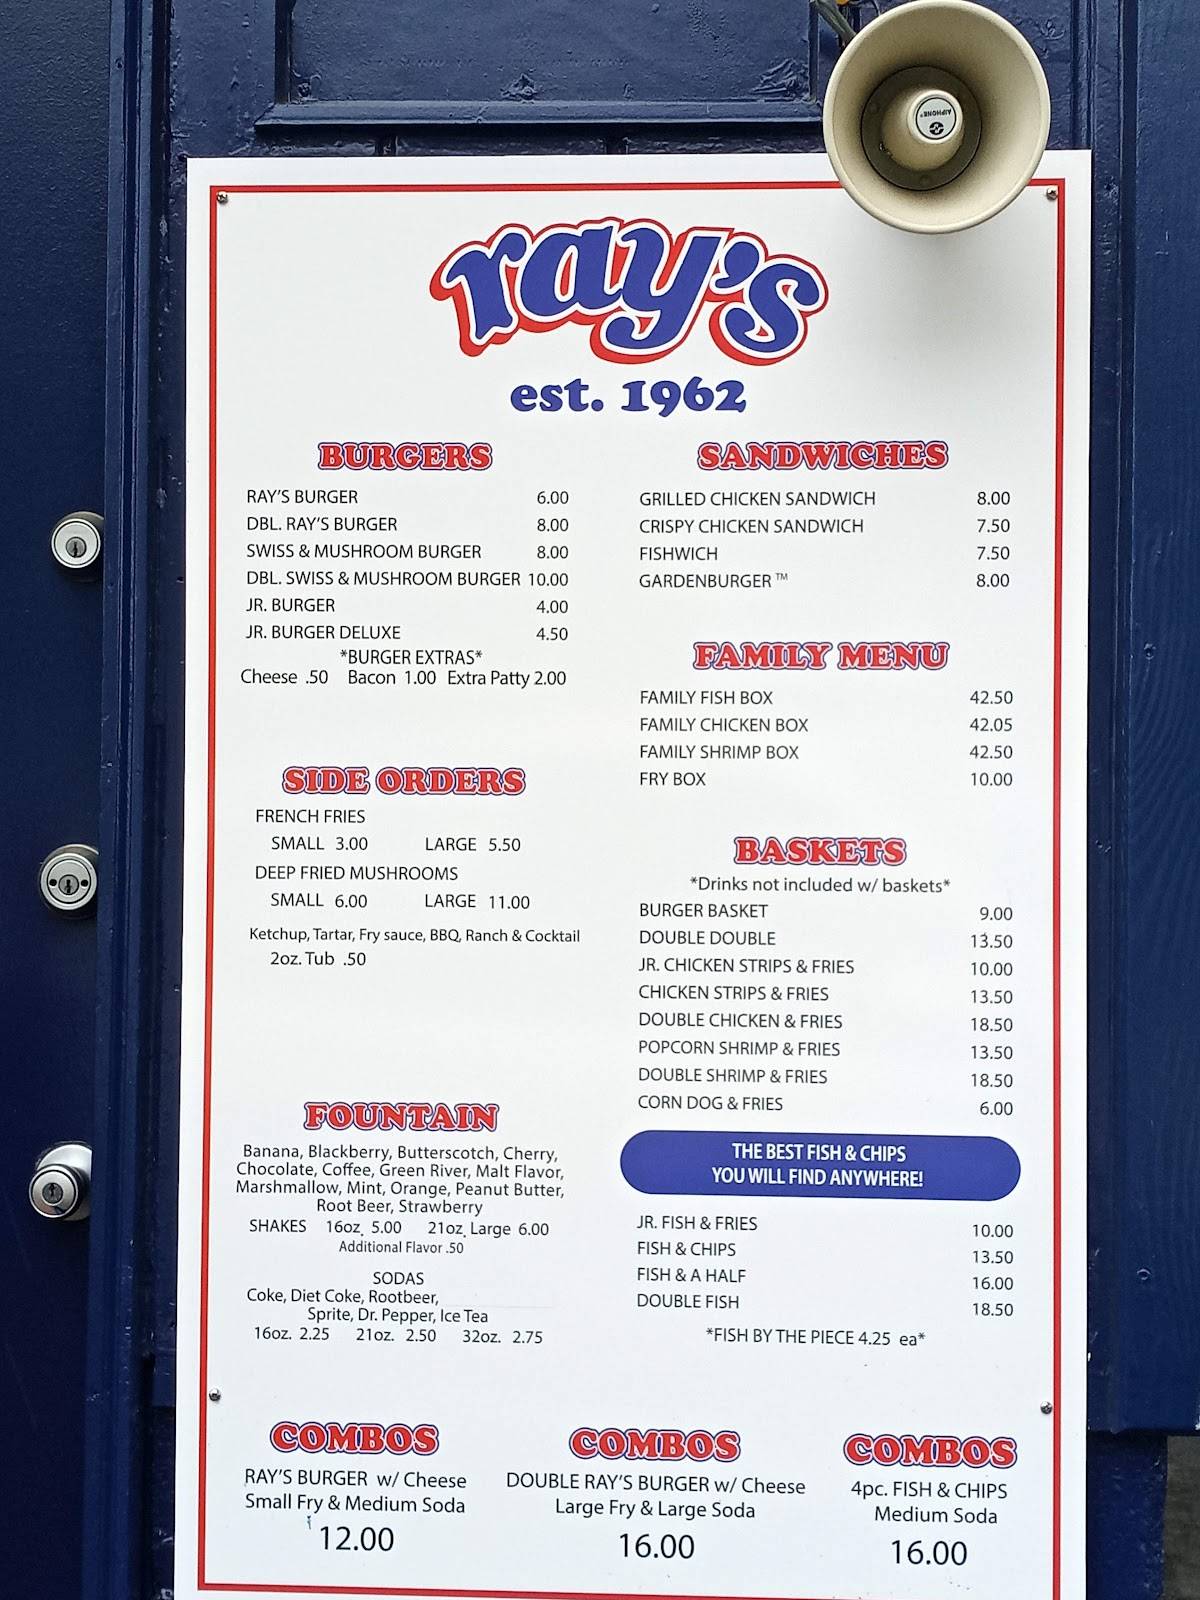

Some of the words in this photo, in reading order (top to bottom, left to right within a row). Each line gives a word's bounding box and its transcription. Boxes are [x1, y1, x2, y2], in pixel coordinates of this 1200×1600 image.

[429, 217, 829, 366] ray's
[510, 378, 604, 413] est.
[621, 376, 747, 418] 1962
[318, 442, 493, 471] BURGERS
[697, 440, 949, 471] SANDWICHES
[247, 489, 290, 504] RAY'S
[294, 489, 358, 504] BURGER
[537, 490, 569, 505] 6.00
[639, 492, 706, 506] GRILLED
[710, 492, 781, 506] CHICKEN
[785, 491, 876, 506] SANDWICH
[977, 491, 1011, 506] 8.00
[247, 570, 282, 585] DBL.
[286, 570, 334, 586] SWISS
[338, 571, 350, 586] &
[354, 571, 452, 586] MUSHROOM
[457, 571, 521, 586] BURGER
[528, 572, 569, 587] 10.00
[639, 574, 772, 588] GARDENBURGER
[976, 573, 1010, 588] 8.00
[693, 642, 833, 670] FAMILY
[837, 642, 950, 670] MENU
[240, 668, 298, 684] Cheese
[306, 669, 328, 684] .50
[348, 669, 396, 685] Bacon
[404, 670, 437, 685] 1.00
[448, 670, 486, 686] Extra
[490, 670, 530, 690] Patty
[534, 670, 566, 686] 2.00
[640, 690, 696, 704] FAMILY
[700, 690, 735, 705] FISH
[740, 690, 773, 705] BOX
[970, 690, 1014, 705] 42.50
[640, 717, 696, 732] FAMILY
[700, 718, 770, 732] CHICKEN
[776, 718, 808, 732] BOX
[969, 717, 1012, 732] 42.05
[282, 766, 370, 795] SIDE
[376, 767, 526, 795] ORDERS
[256, 809, 319, 824] FRENCH
[324, 809, 366, 824] FRIES
[271, 836, 325, 850] SMALL
[336, 836, 368, 851] 3.00
[425, 837, 477, 852] LARGE
[488, 838, 521, 852] 5.50
[734, 837, 906, 866] BASKETS
[255, 865, 296, 880] DEEP
[300, 865, 346, 880] FRIED
[350, 866, 458, 881] MUSHROOMS
[752, 878, 780, 892] not
[784, 876, 853, 892] included
[857, 878, 879, 893] w/
[640, 902, 704, 918] BURGER
[708, 903, 769, 918] BASKET
[980, 906, 1013, 921] 9.00
[250, 927, 310, 944] Ketchup,
[312, 928, 356, 942] Tartar,
[359, 928, 381, 944] Fry
[384, 931, 426, 943] sauce,
[430, 928, 462, 943] BBQ,
[466, 928, 508, 942] Ranch
[511, 929, 522, 942] &
[525, 929, 580, 942] Cocktail
[270, 951, 302, 966] 2oz.
[304, 950, 335, 966] Tub
[343, 952, 366, 966] .50
[638, 957, 660, 972] JR.
[664, 957, 734, 972] CHICKEN
[739, 958, 792, 974] STRIPS
[796, 959, 808, 974] &
[812, 959, 854, 974] FRIES
[971, 962, 1013, 976] 10.00
[638, 1040, 714, 1054] POPCORN
[719, 1041, 778, 1056] SHRIMP
[782, 1042, 794, 1056] &
[798, 1042, 840, 1057] FRIES
[971, 1045, 1013, 1060] 13.50
[303, 1102, 499, 1132] FOUNTAIN
[243, 1144, 304, 1160] Banana,
[308, 1144, 392, 1162] Blackberry,
[398, 1145, 499, 1162] Butterscotch,
[503, 1146, 558, 1164] Cherry,
[732, 1142, 763, 1159] THE
[766, 1143, 804, 1160] BEST
[807, 1144, 841, 1160] FISH
[844, 1145, 857, 1161] &
[860, 1145, 906, 1162] CHIPS
[712, 1167, 745, 1184] YOU
[748, 1168, 786, 1184] WILL
[789, 1168, 826, 1185] FIND
[830, 1169, 923, 1187] ANYWHERE!
[317, 1198, 352, 1212] Root
[357, 1198, 394, 1215] Beer,
[398, 1199, 483, 1218] Strawberry
[249, 1218, 307, 1233] SHAKES
[326, 1220, 364, 1237] 16oz.
[371, 1220, 402, 1234] 5.00
[636, 1215, 658, 1229] JR.
[662, 1215, 696, 1230] FISH
[699, 1216, 711, 1230] &
[715, 1216, 758, 1231] FRIES
[972, 1224, 1014, 1238] 10.00
[338, 1240, 402, 1253] Additional
[406, 1240, 443, 1254] Flavor
[446, 1242, 464, 1254] .50
[372, 1271, 424, 1286] SODAS
[637, 1267, 671, 1282] FISH
[675, 1268, 687, 1282] &
[690, 1268, 702, 1282] A
[706, 1268, 746, 1283] HALF
[972, 1276, 1014, 1291] 16.00
[247, 1287, 287, 1304] Coke,
[291, 1288, 321, 1303] Diet
[324, 1288, 365, 1305] Coke,
[368, 1289, 439, 1306] Rootbeer,
[254, 1326, 292, 1340] 16oz.
[299, 1326, 330, 1341] 2.25
[462, 1329, 502, 1344] 32oz.
[512, 1330, 543, 1344] 2.75
[753, 1328, 773, 1343] BY
[775, 1329, 807, 1344] THE
[811, 1330, 854, 1345] PIECE
[858, 1331, 891, 1346] 4.25
[270, 1421, 439, 1455] COMBOS
[843, 1433, 1018, 1468] COMBOS
[244, 1468, 292, 1487] RAY'S
[298, 1469, 368, 1486] BURGER
[376, 1471, 400, 1488] w/
[404, 1471, 467, 1489] Cheese
[850, 1480, 888, 1500] 4pc.
[893, 1481, 932, 1498] FISH
[937, 1482, 950, 1498] &
[954, 1482, 1008, 1499] CHIPS
[245, 1492, 292, 1510] Small
[297, 1494, 324, 1514] Fry
[328, 1494, 341, 1511] &
[345, 1495, 417, 1512] Medium
[422, 1496, 465, 1514] Soda
[874, 1505, 948, 1523] Medium
[953, 1507, 998, 1524] Soda
[320, 1526, 394, 1552] 12.00
[891, 1539, 968, 1566] 16.00
